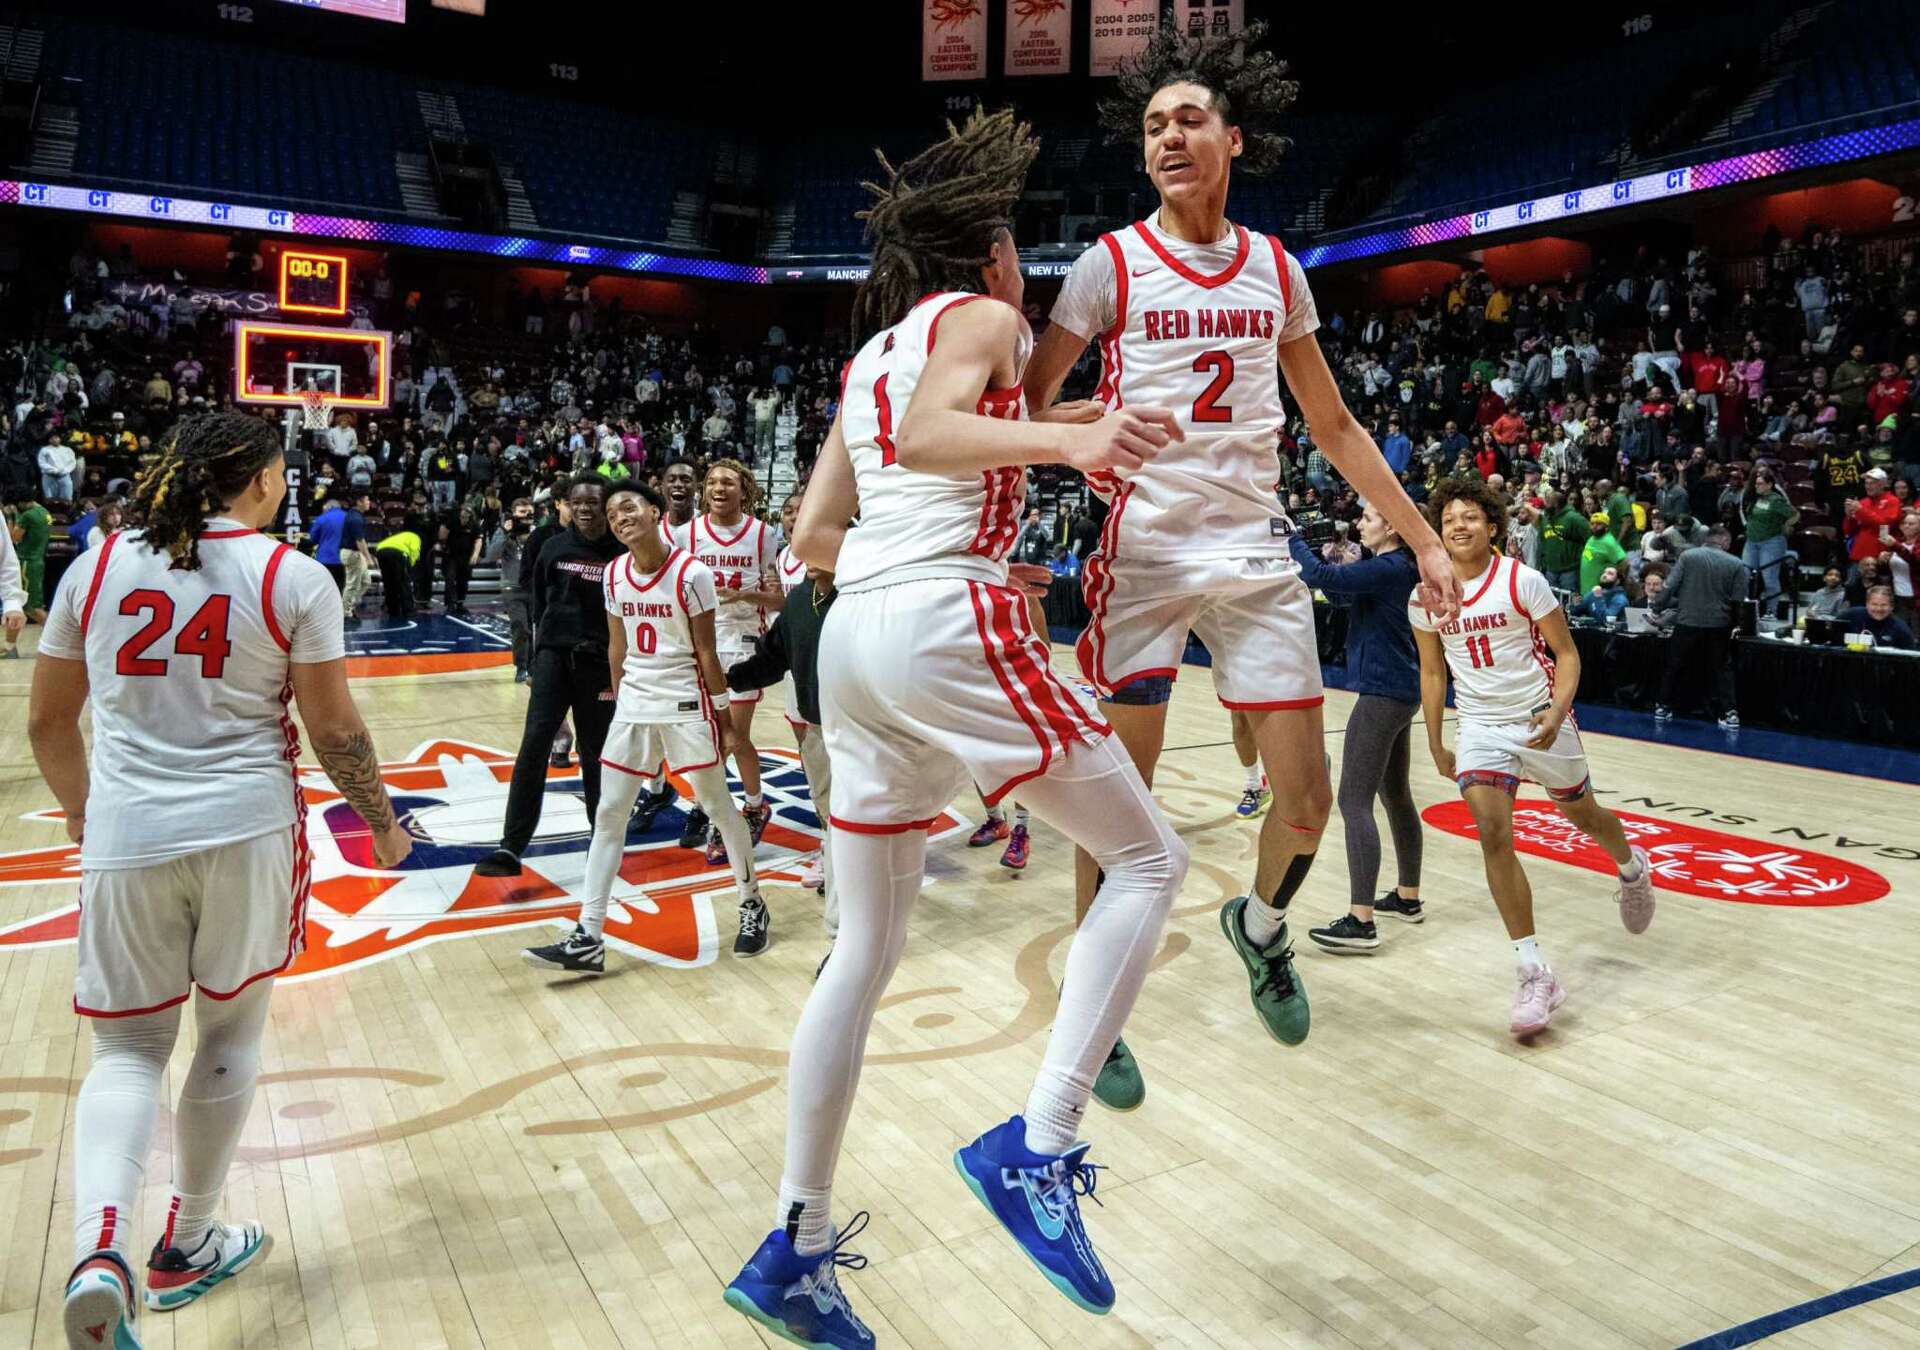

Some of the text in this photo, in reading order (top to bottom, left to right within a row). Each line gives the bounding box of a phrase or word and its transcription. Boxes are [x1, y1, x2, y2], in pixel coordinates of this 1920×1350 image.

[218, 4, 254, 22] 112
[1095, 13, 1155, 24] 2004 2005
[1095, 27, 1123, 37] 2019
[1622, 14, 1652, 36] 116
[938, 45, 971, 54] EASTERN
[1021, 39, 1055, 48] EASTERN
[930, 53, 979, 63] CONFERENCE
[1013, 48, 1062, 58] CONFERENCE
[932, 63, 977, 72] CHAMPIONS
[1014, 57, 1060, 67] CHAMPIONS
[549, 63, 578, 80] 113
[945, 96, 971, 110] 114
[1666, 169, 1687, 189] CT
[24, 183, 48, 200] CT
[88, 191, 111, 207] CT
[1613, 181, 1632, 200] CT
[150, 197, 172, 213] CT
[1564, 191, 1582, 210] CT
[210, 203, 231, 220] CT
[268, 210, 289, 226] CT
[1518, 202, 1535, 220] CT
[1475, 211, 1490, 229] CT
[827, 269, 871, 280] MANCHE
[1029, 266, 1052, 276] NEW
[1144, 308, 1274, 341] RED HAWKS
[1192, 350, 1234, 422] 2
[873, 371, 897, 468] 1
[1829, 464, 1859, 486] 24
[285, 468, 302, 544] CIAC
[720, 554, 752, 567] HAWKS
[619, 602, 673, 618] ED HAWKS
[1463, 612, 1508, 632] HAWKS
[116, 588, 231, 679] 24
[636, 622, 657, 655] 0
[1466, 634, 1494, 669] 11
[1621, 796, 1758, 826] SUN
